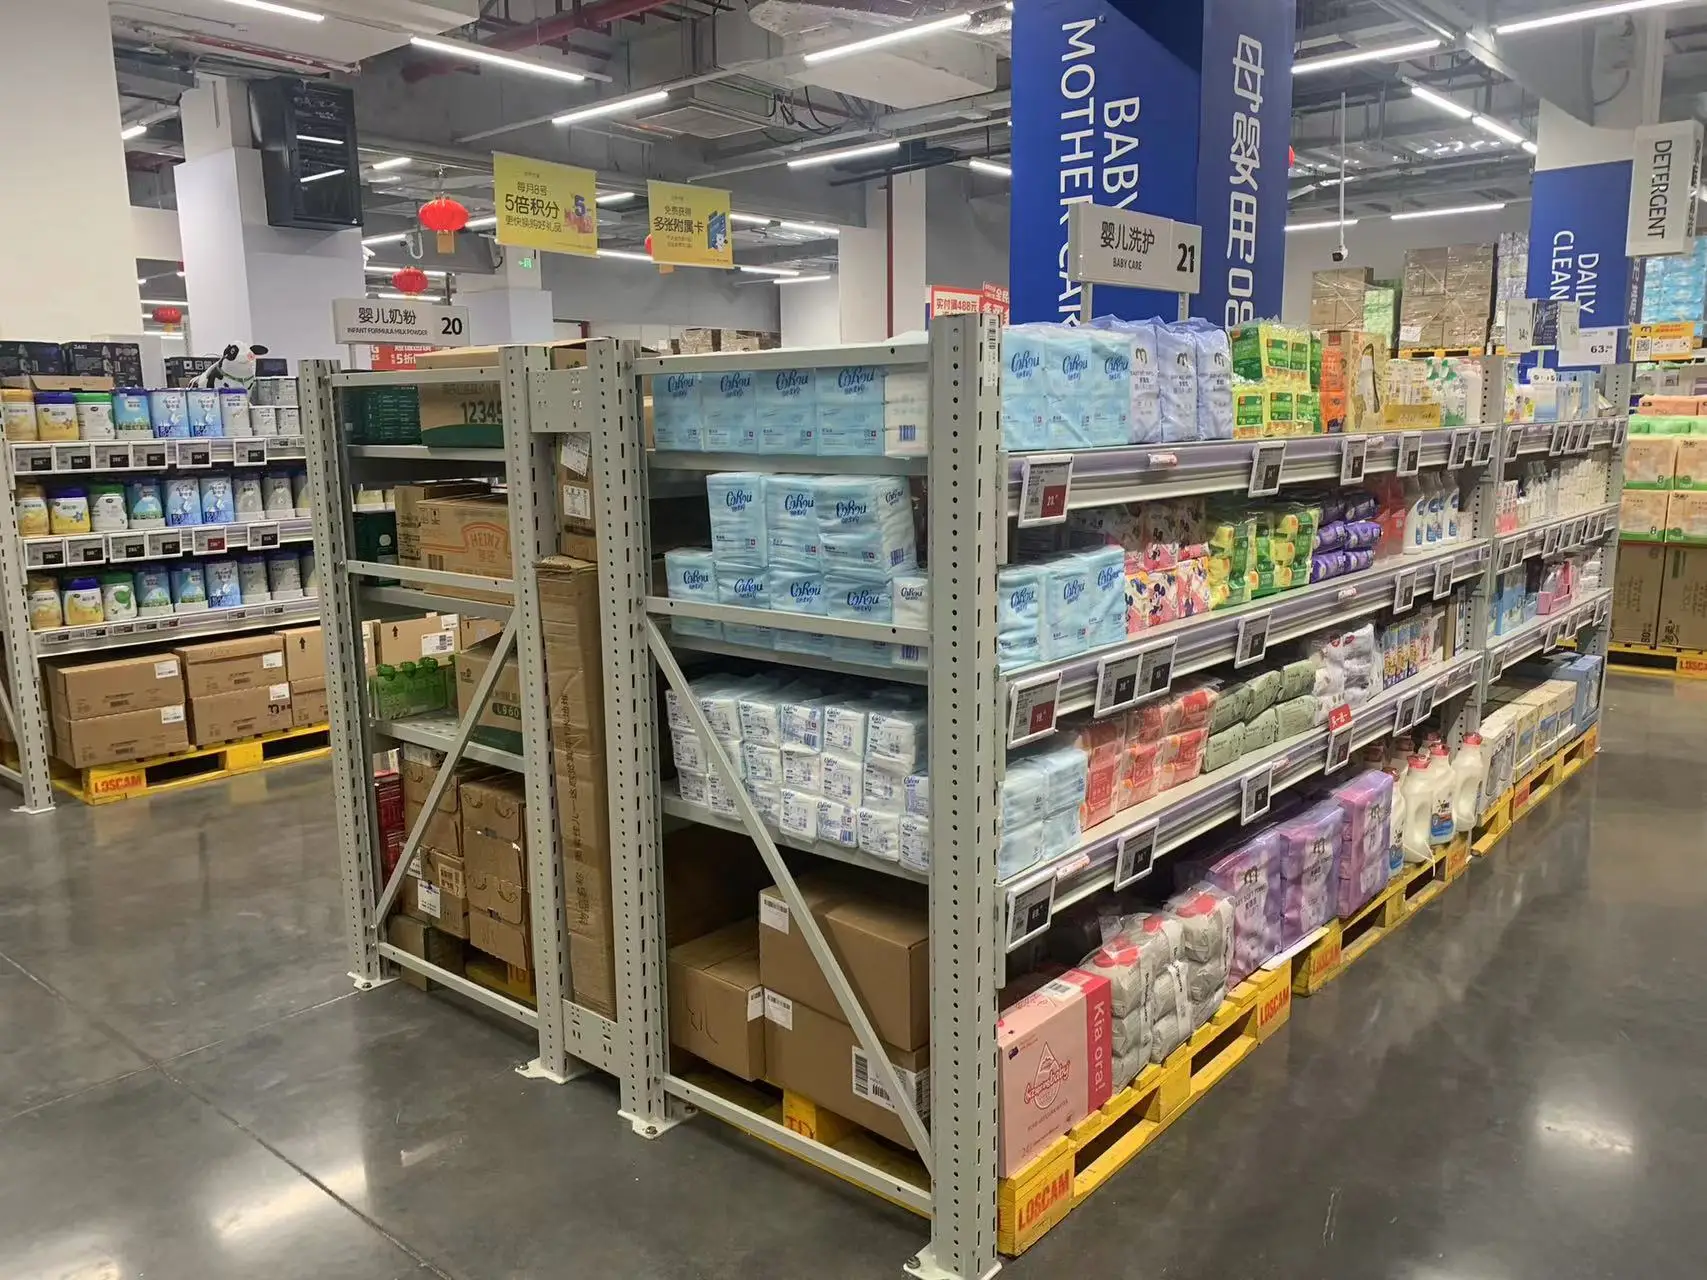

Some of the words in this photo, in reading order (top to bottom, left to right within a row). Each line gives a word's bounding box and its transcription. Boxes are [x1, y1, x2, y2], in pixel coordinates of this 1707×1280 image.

[1226, 34, 1264, 334] 母婴用品
[1647, 139, 1673, 239] DETERGENT
[504, 193, 561, 219] 5倍积分
[653, 216, 705, 235] 多张附属卡
[1100, 220, 1155, 255] 婴儿洗护
[1112, 257, 1128, 269] BABY
[1128, 260, 1143, 271] CARE
[1176, 242, 1195, 273] 21
[1575, 252, 1600, 314] DAILY
[358, 307, 417, 325] 婴儿奶粉
[441, 317, 463, 335] 20
[367, 327, 394, 335] FORMULA
[470, 531, 501, 549] HEINZ
[95, 775, 142, 793] LOSCAM
[1093, 1000, 1106, 1041] Kia
[1093, 1047, 1106, 1092] ora!
[1018, 1170, 1070, 1231] LOSCAM
